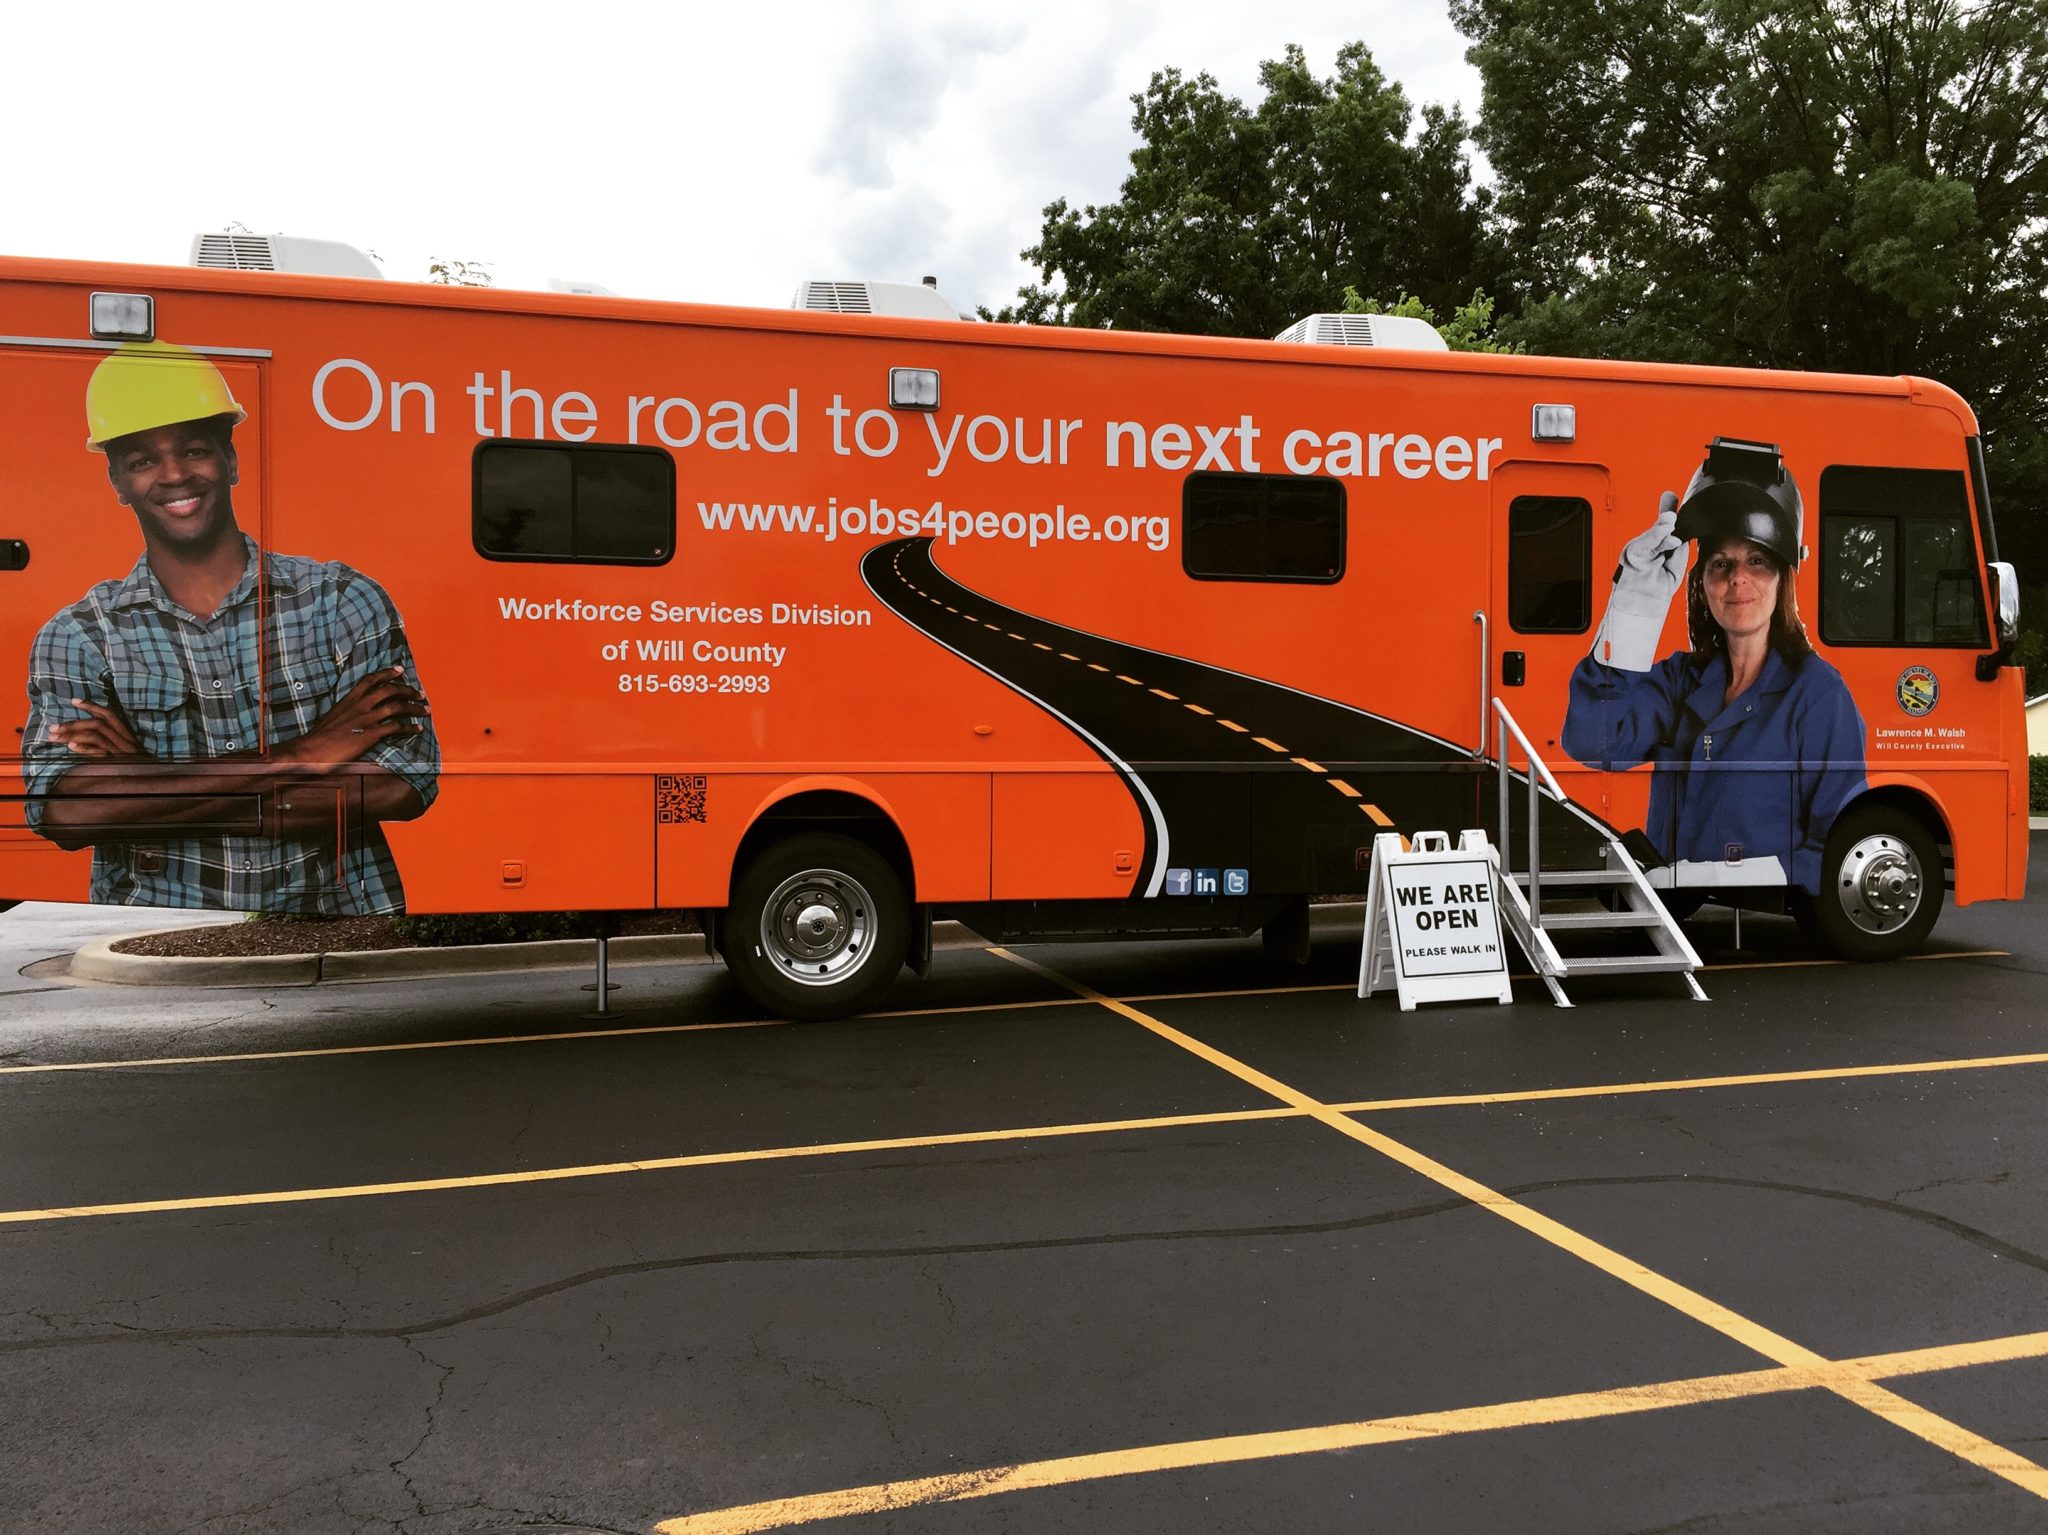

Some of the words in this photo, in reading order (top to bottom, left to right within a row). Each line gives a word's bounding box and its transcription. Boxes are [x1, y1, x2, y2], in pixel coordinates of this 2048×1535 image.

[312, 358, 435, 433] On
[466, 370, 598, 442] the
[628, 388, 798, 453] road
[826, 394, 899, 458] to
[923, 413, 1083, 477] your
[1106, 415, 1261, 473] next
[1283, 428, 1503, 481] career
[697, 497, 1170, 551] www.jobs4people.org
[498, 598, 642, 622] Workforce
[650, 600, 763, 624] Services
[772, 603, 872, 626] Division
[601, 639, 629, 661] of
[636, 640, 685, 662] Will
[692, 640, 786, 667] County
[618, 674, 771, 693] 815-693-2993
[1876, 728, 1921, 737] Lawrence
[1924, 728, 1936, 737] M.
[1938, 728, 1966, 737] Walsh
[1894, 743, 1923, 751] County
[1396, 886, 1433, 906] WE
[1443, 883, 1490, 904] ARE
[1416, 909, 1479, 931] OPEN
[1405, 946, 1447, 957] PLEASE
[1450, 944, 1480, 955] WALK
[1485, 944, 1496, 953] IN
